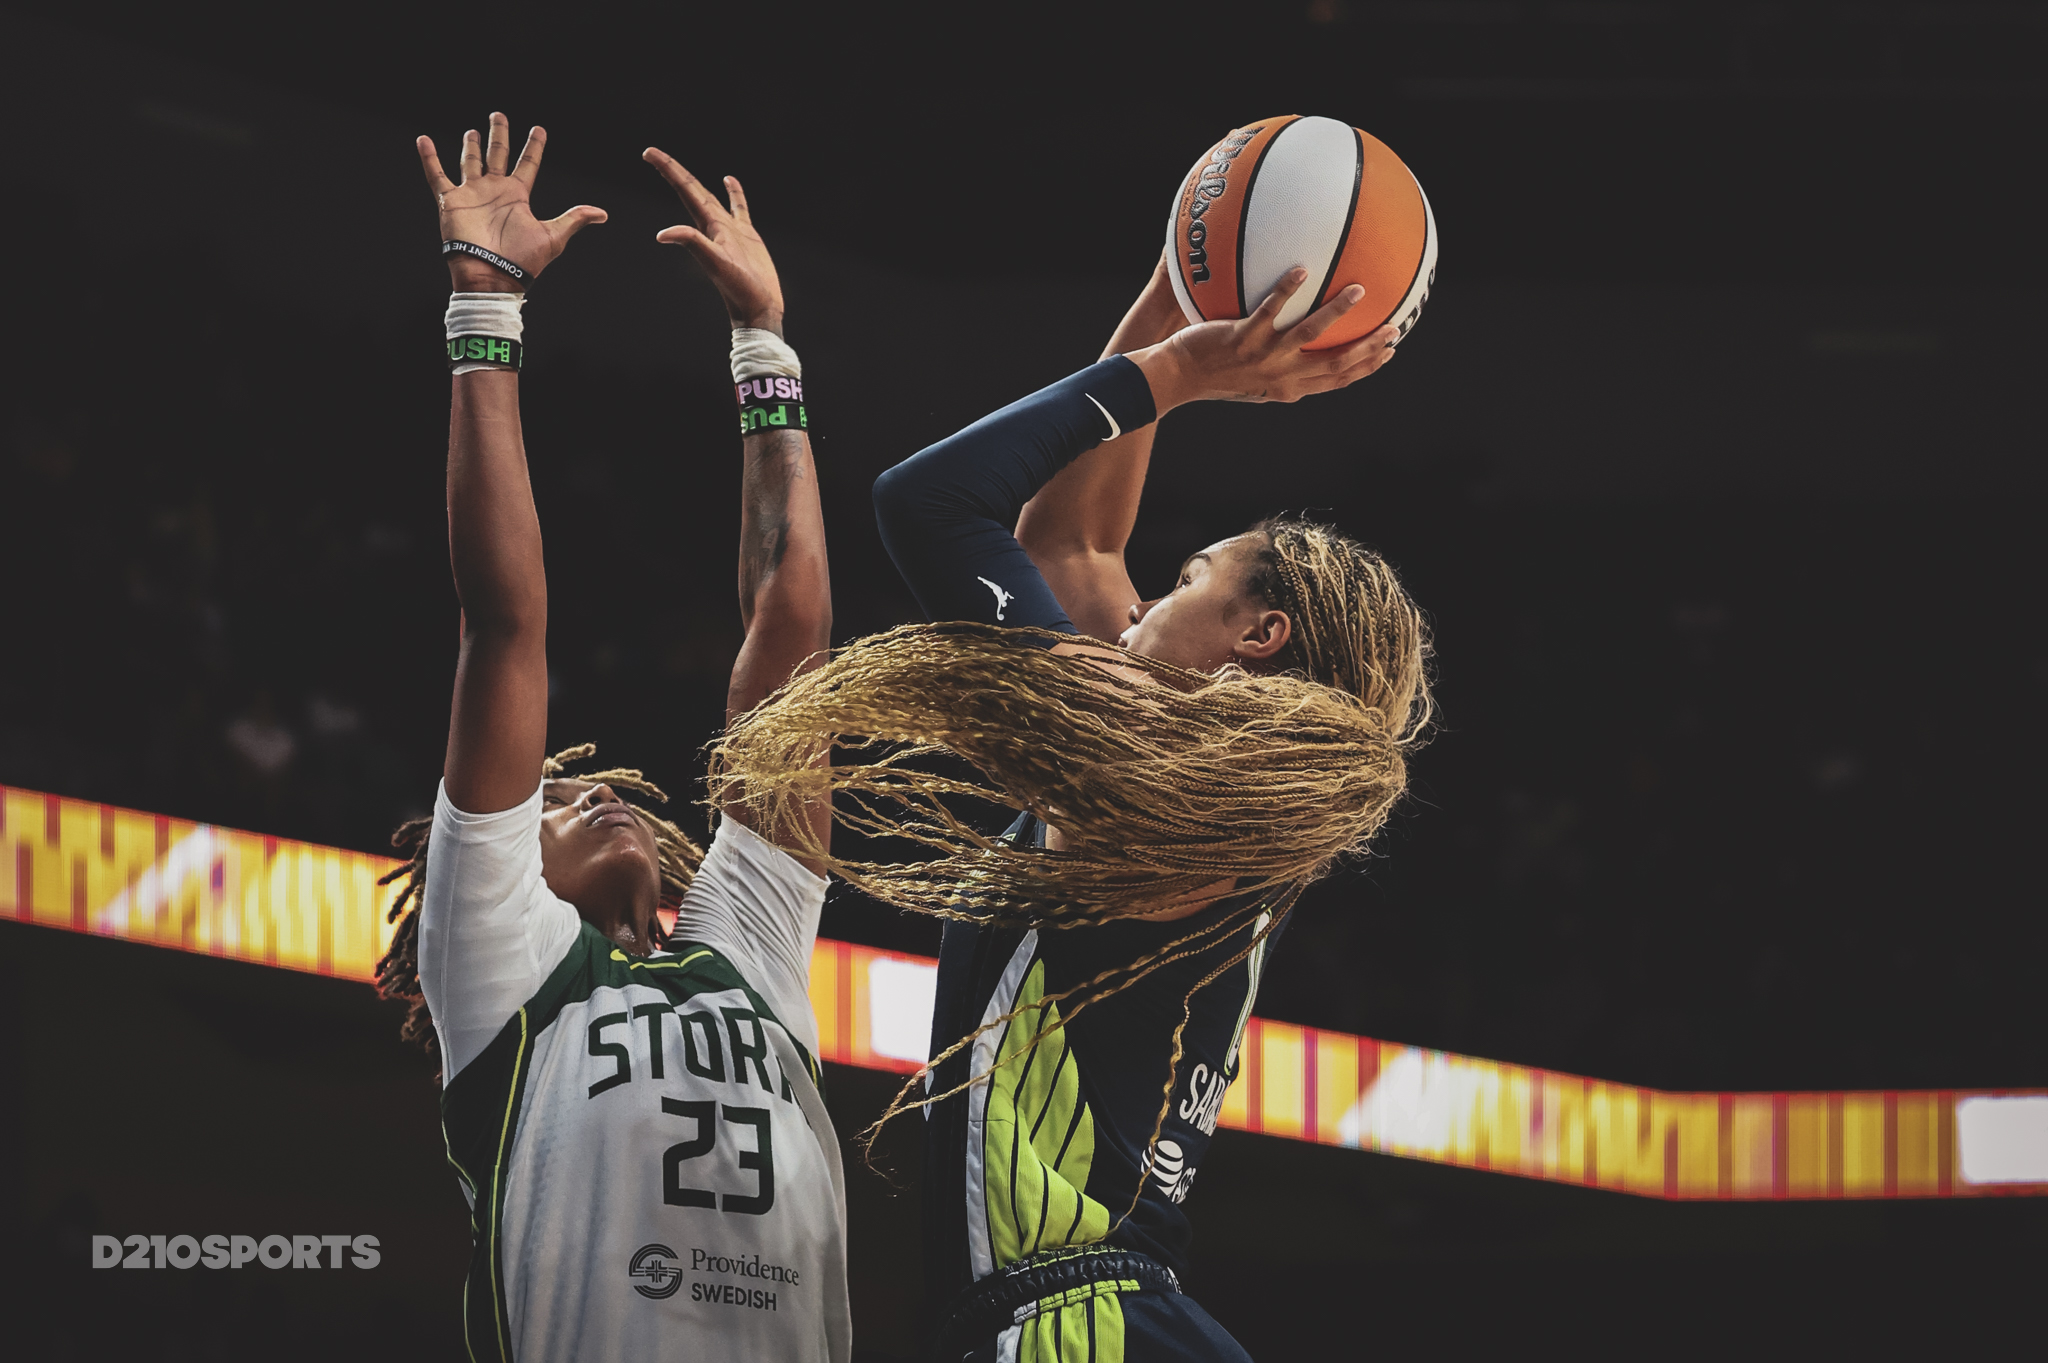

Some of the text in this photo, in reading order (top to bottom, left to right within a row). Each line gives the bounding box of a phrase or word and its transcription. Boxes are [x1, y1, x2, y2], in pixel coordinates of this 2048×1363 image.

[452, 242, 467, 252] HE
[468, 245, 523, 279] CONFIDENT
[738, 377, 804, 405] PUSH
[660, 1095, 776, 1216] 23
[690, 1247, 800, 1287] Providence
[691, 1282, 778, 1312] SWEDISH
